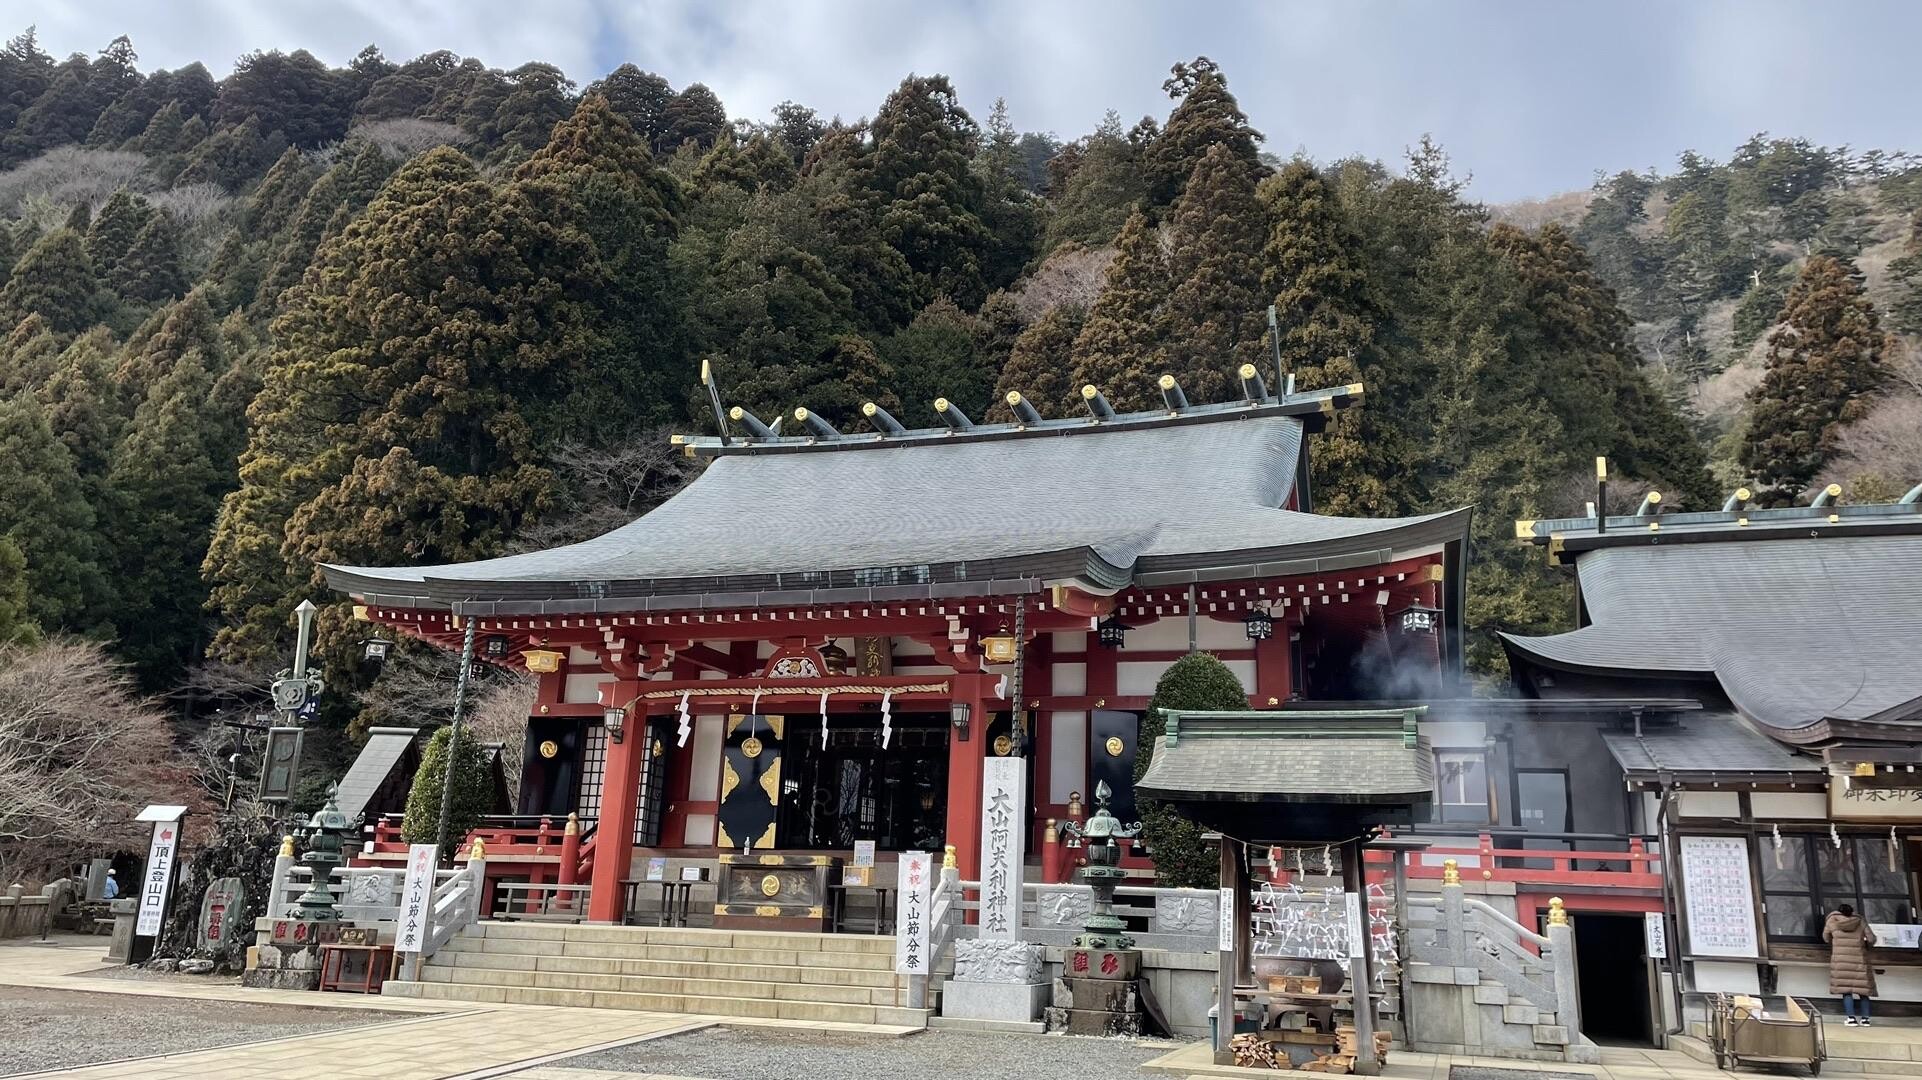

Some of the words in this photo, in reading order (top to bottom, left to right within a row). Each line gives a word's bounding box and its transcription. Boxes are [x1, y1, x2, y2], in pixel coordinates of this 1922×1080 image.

[146, 846, 170, 907] 頂上登山口
[986, 786, 1014, 933] 大山阿夫利神社
